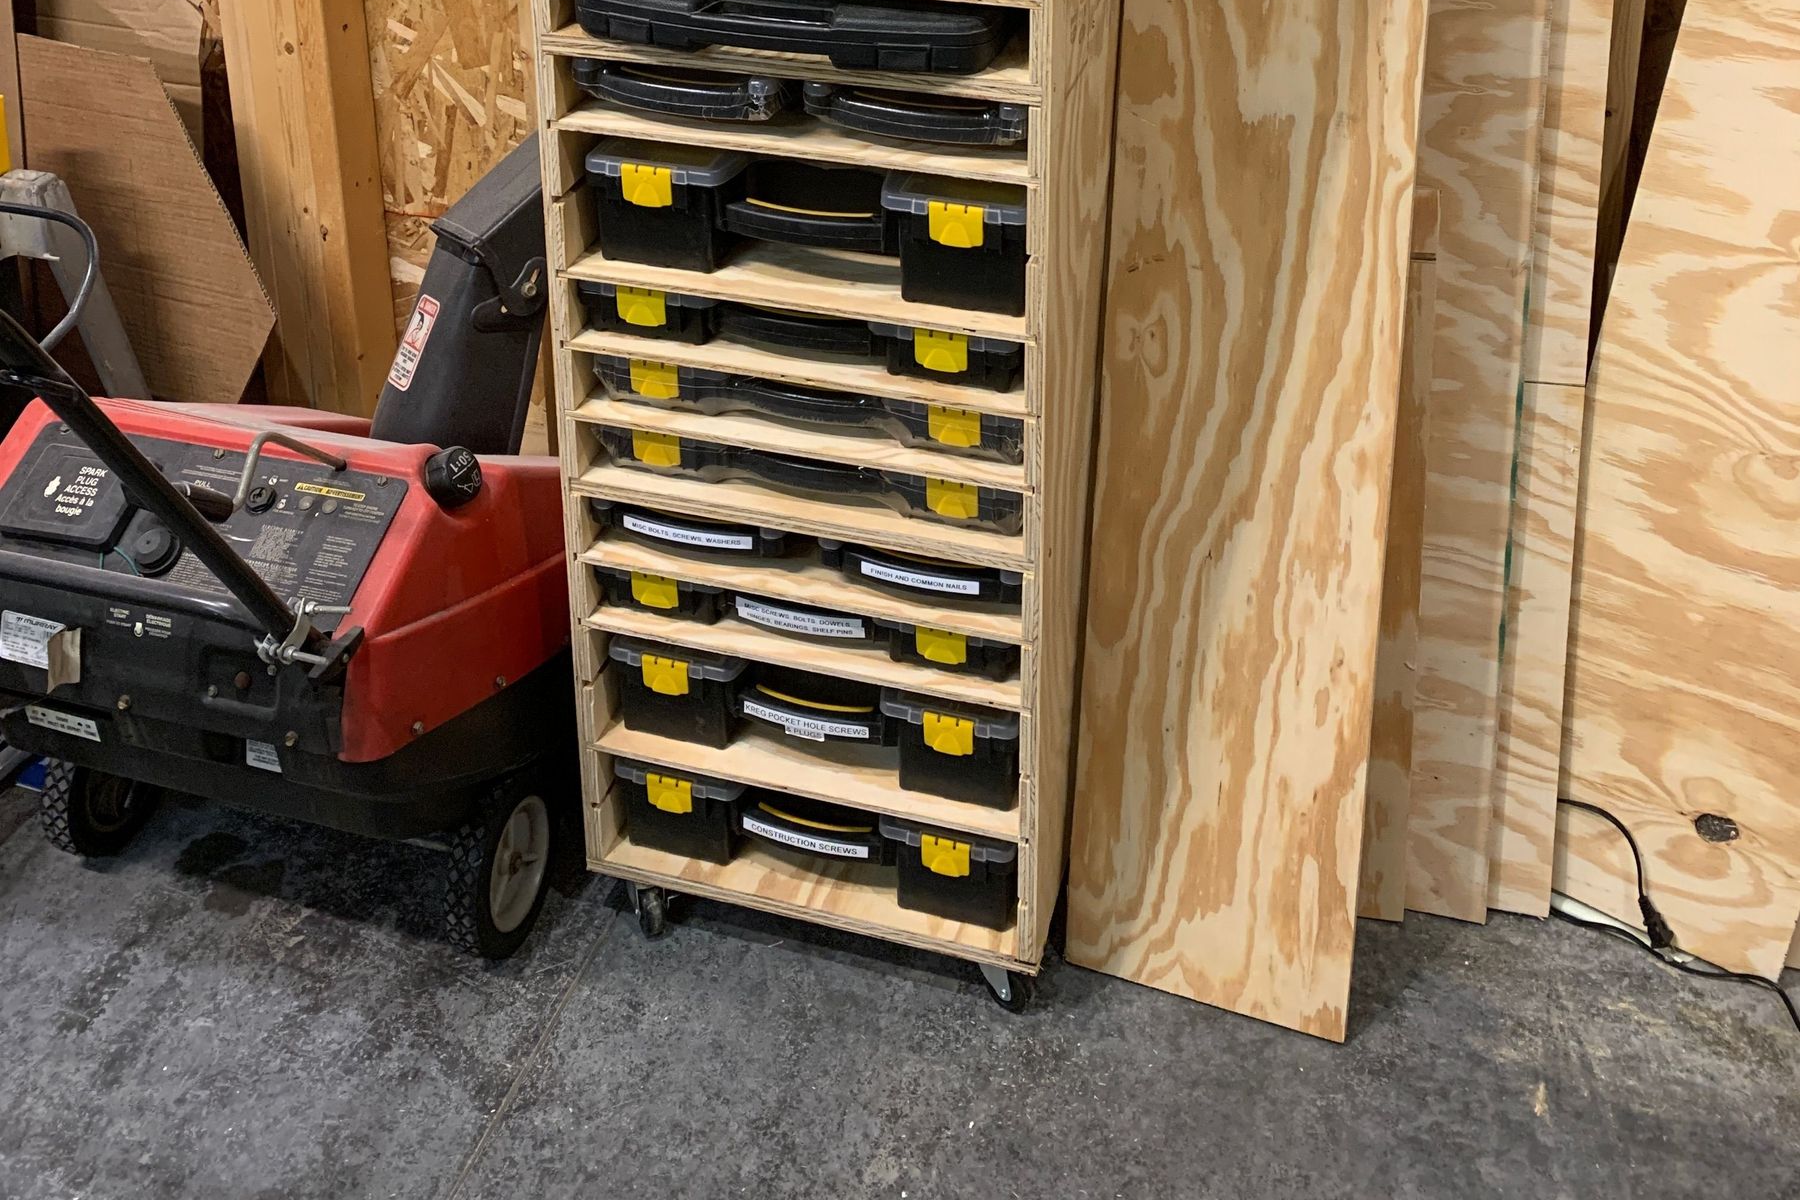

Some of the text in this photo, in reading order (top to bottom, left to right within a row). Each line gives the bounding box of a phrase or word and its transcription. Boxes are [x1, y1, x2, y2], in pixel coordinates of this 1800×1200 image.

[79, 466, 108, 477] SPARK
[75, 476, 99, 486] PLUG
[64, 484, 98, 497] ACCESS
[55, 503, 82, 517] bougie
[631, 521, 647, 530] MISC
[705, 537, 741, 546] WASHERS
[870, 568, 893, 578] FINISH
[911, 577, 944, 588] COMMON
[946, 583, 968, 591] NAILS
[745, 703, 867, 736] KREG POCKET HOLE SCREWS
[793, 728, 822, 738] PLUGS
[751, 822, 857, 855] CONSTRUCTION SCREWS
